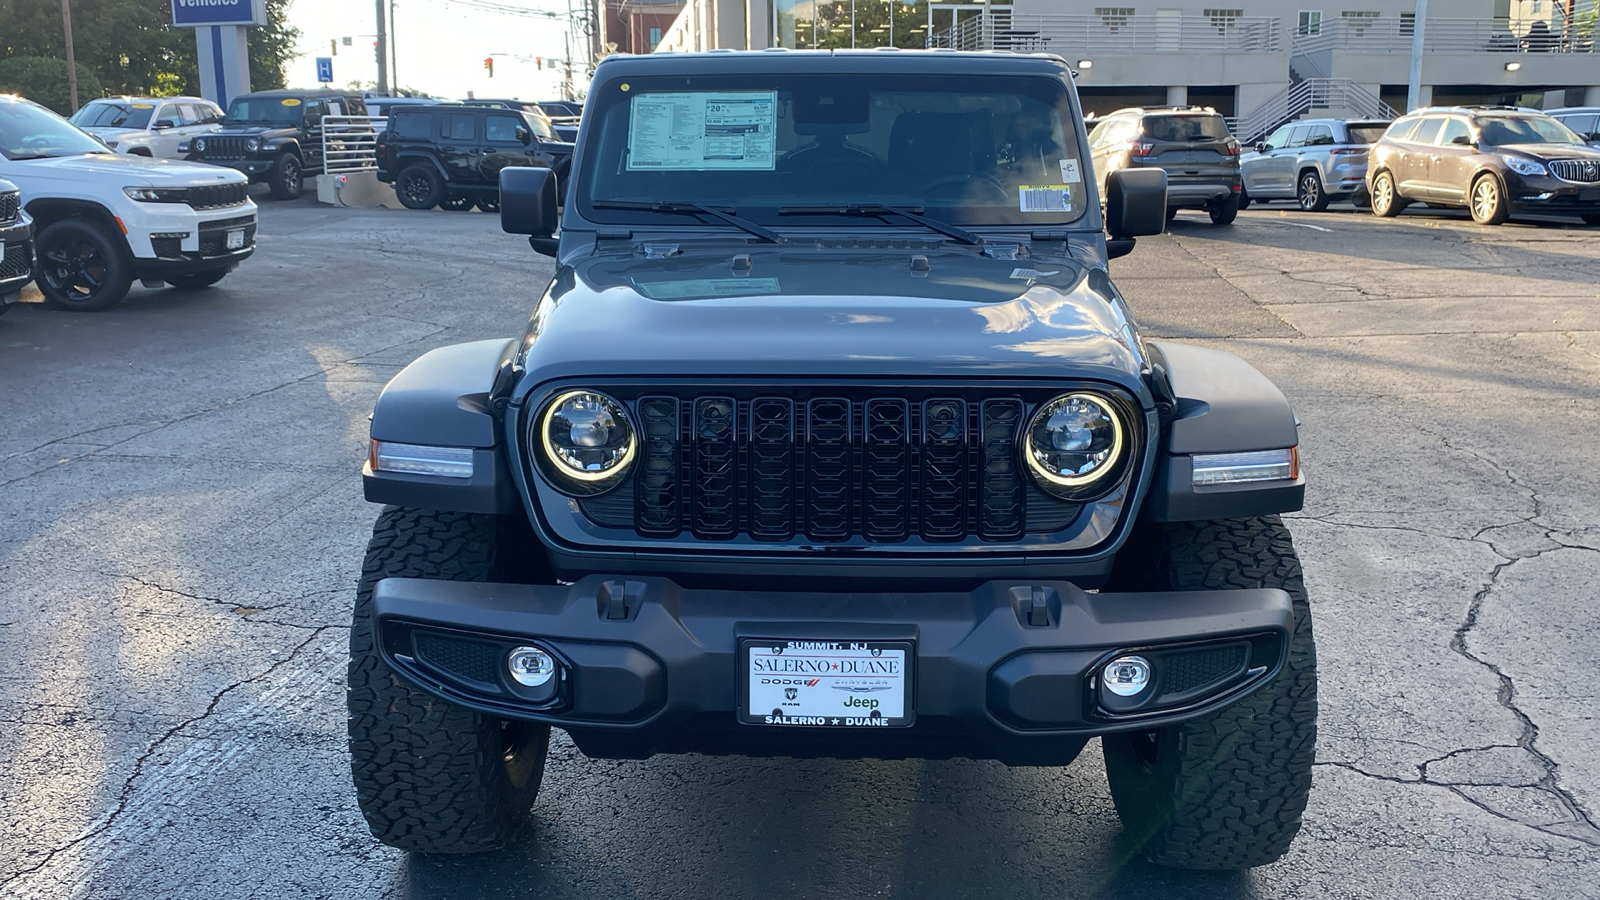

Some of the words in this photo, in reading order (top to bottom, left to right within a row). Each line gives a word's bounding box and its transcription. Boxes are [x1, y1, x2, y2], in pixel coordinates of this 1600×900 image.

[320, 62, 330, 76] H
[787, 642, 843, 650] SUMMIT,
[754, 659, 830, 673] SALERNO
[841, 661, 899, 674] DUANE
[843, 696, 879, 709] Jeep
[765, 716, 825, 725] SALERNO
[845, 718, 888, 726] DUANE
